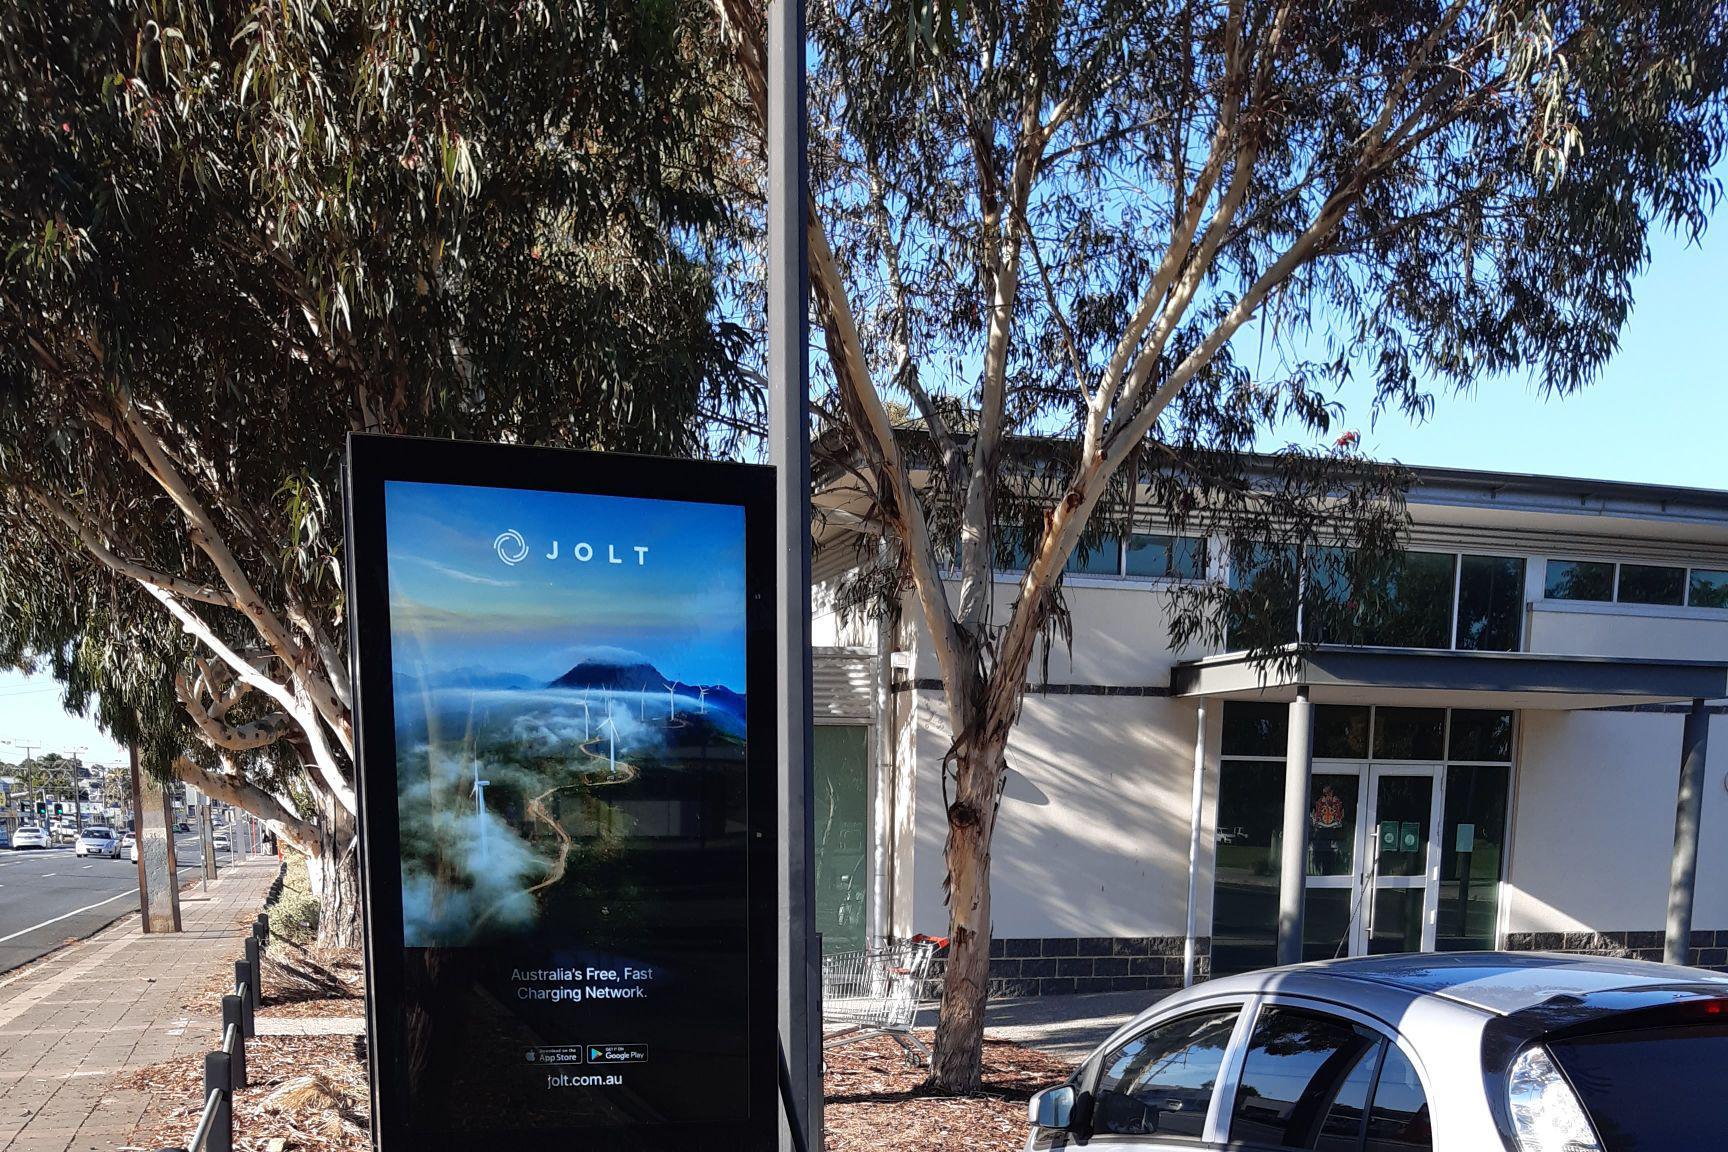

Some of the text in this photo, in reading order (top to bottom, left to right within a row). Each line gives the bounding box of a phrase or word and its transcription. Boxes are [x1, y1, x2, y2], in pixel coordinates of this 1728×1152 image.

[546, 540, 649, 565] JOLT
[511, 967, 653, 983] Australia's Free, Fast
[517, 985, 648, 1003] Charging Network.
[539, 1053, 577, 1063] App Store
[605, 1051, 645, 1061] Google Play
[547, 1073, 623, 1090] jolt.com.au
